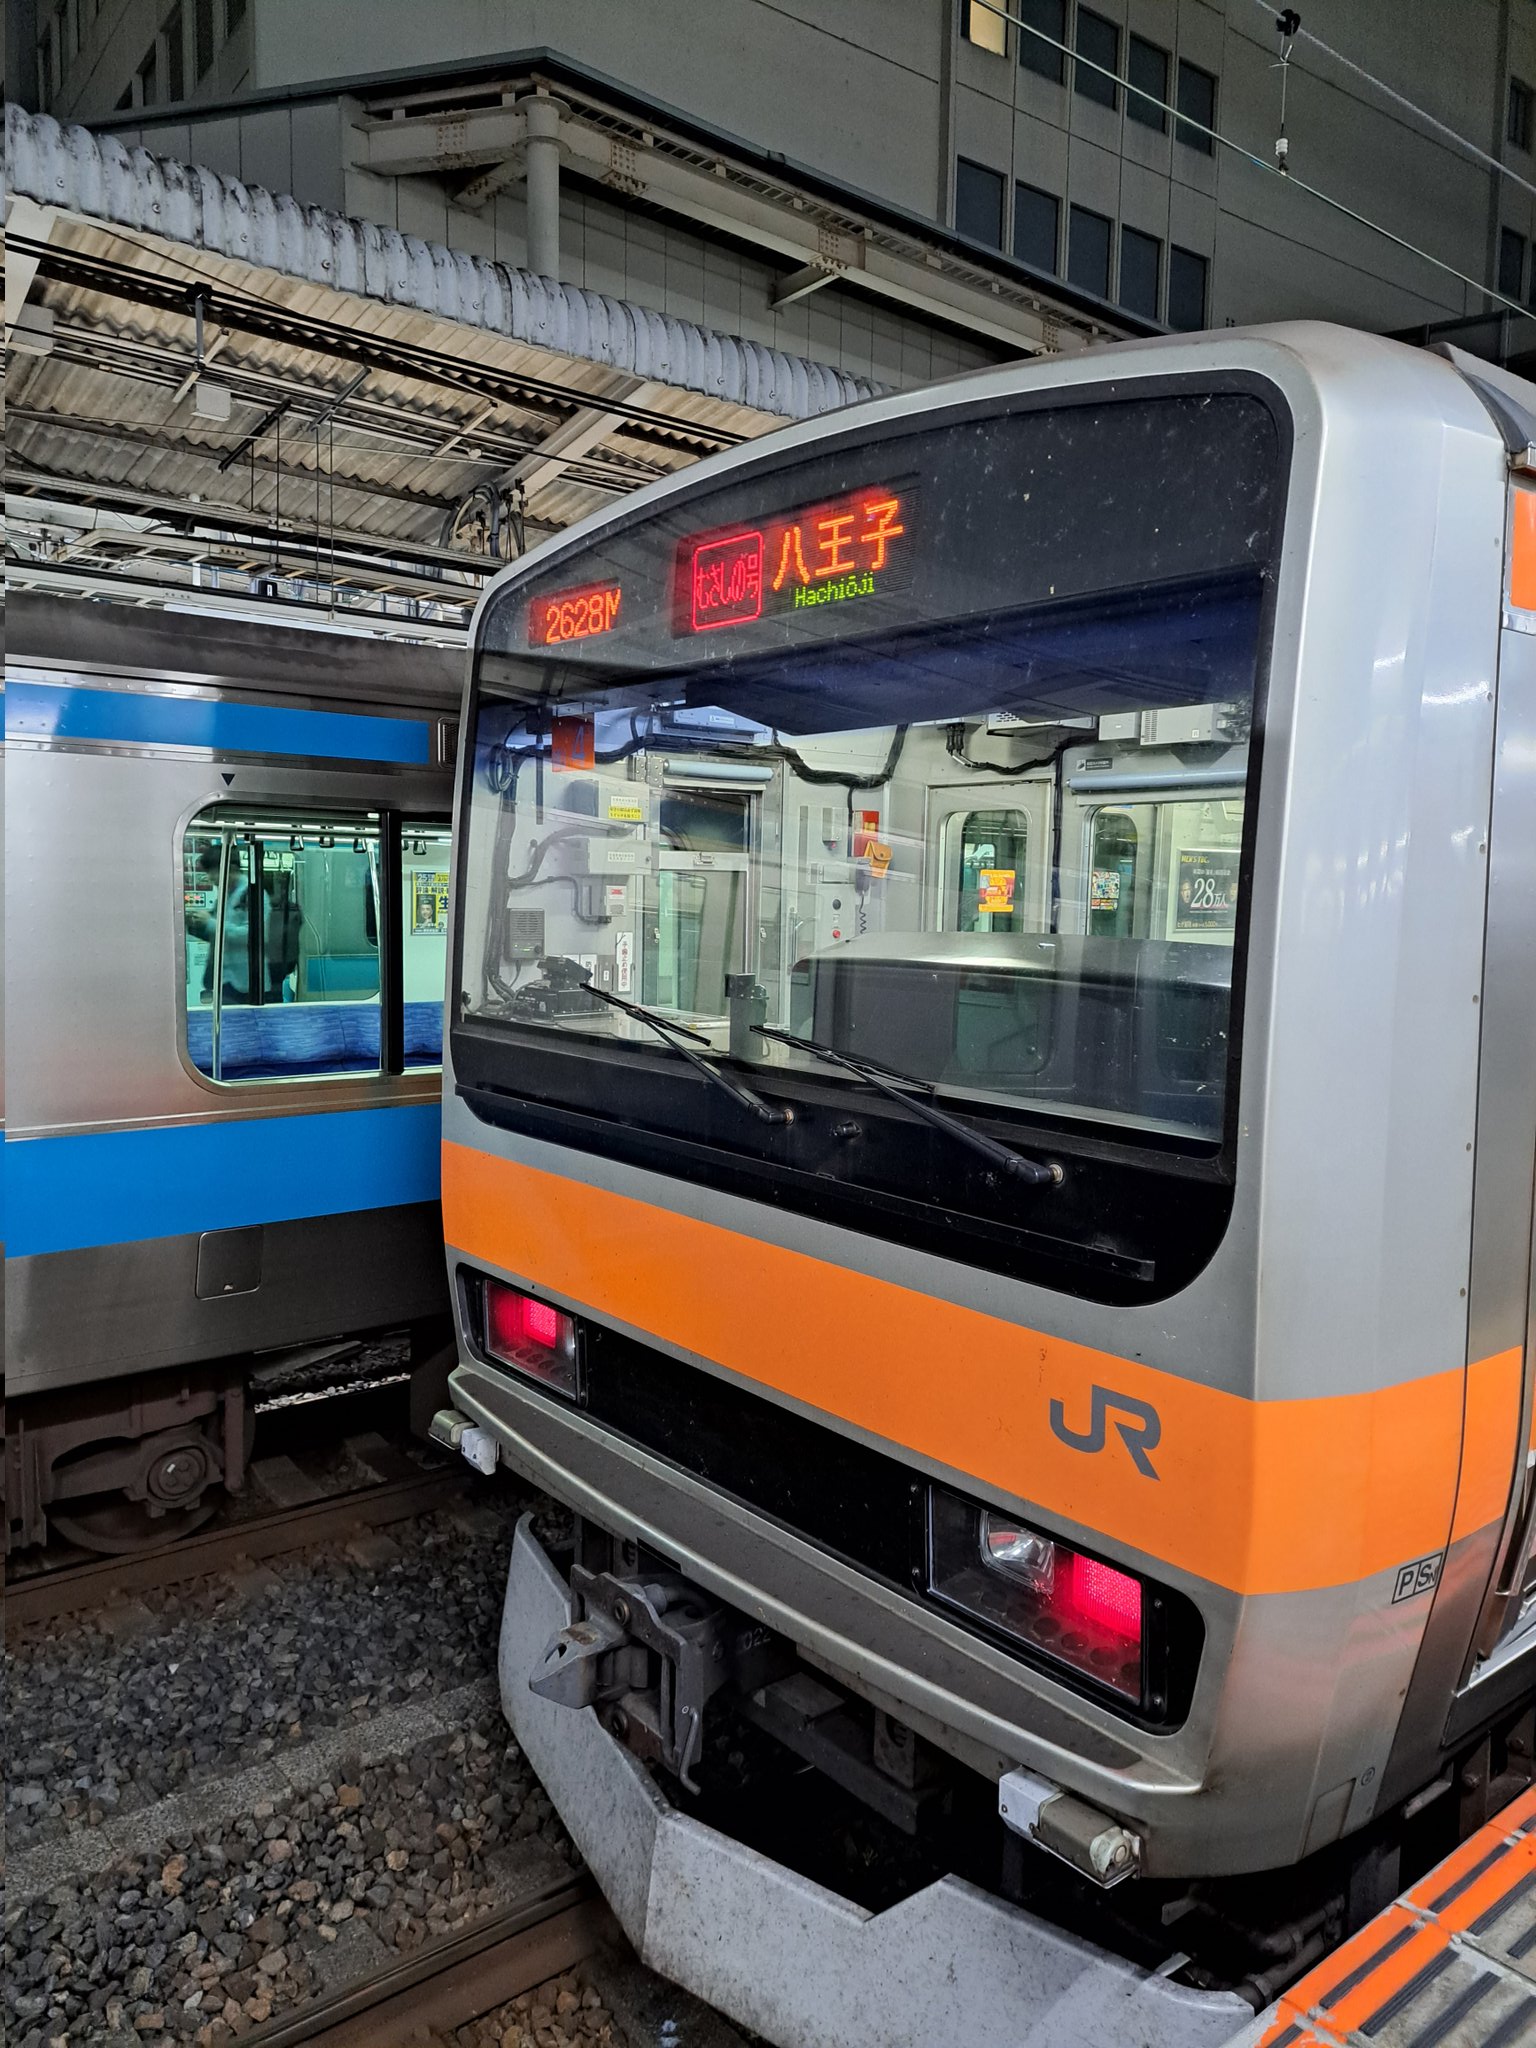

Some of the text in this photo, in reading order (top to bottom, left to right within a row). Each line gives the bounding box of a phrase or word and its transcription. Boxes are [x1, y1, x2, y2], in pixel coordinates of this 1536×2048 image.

[773, 499, 904, 591] 八王子
[696, 552, 759, 610] むさしの号
[794, 571, 875, 608] Hachiōji
[546, 587, 622, 644] 2628M
[1190, 877, 1228, 908] 28万人
[1049, 1384, 1162, 1481] JR
